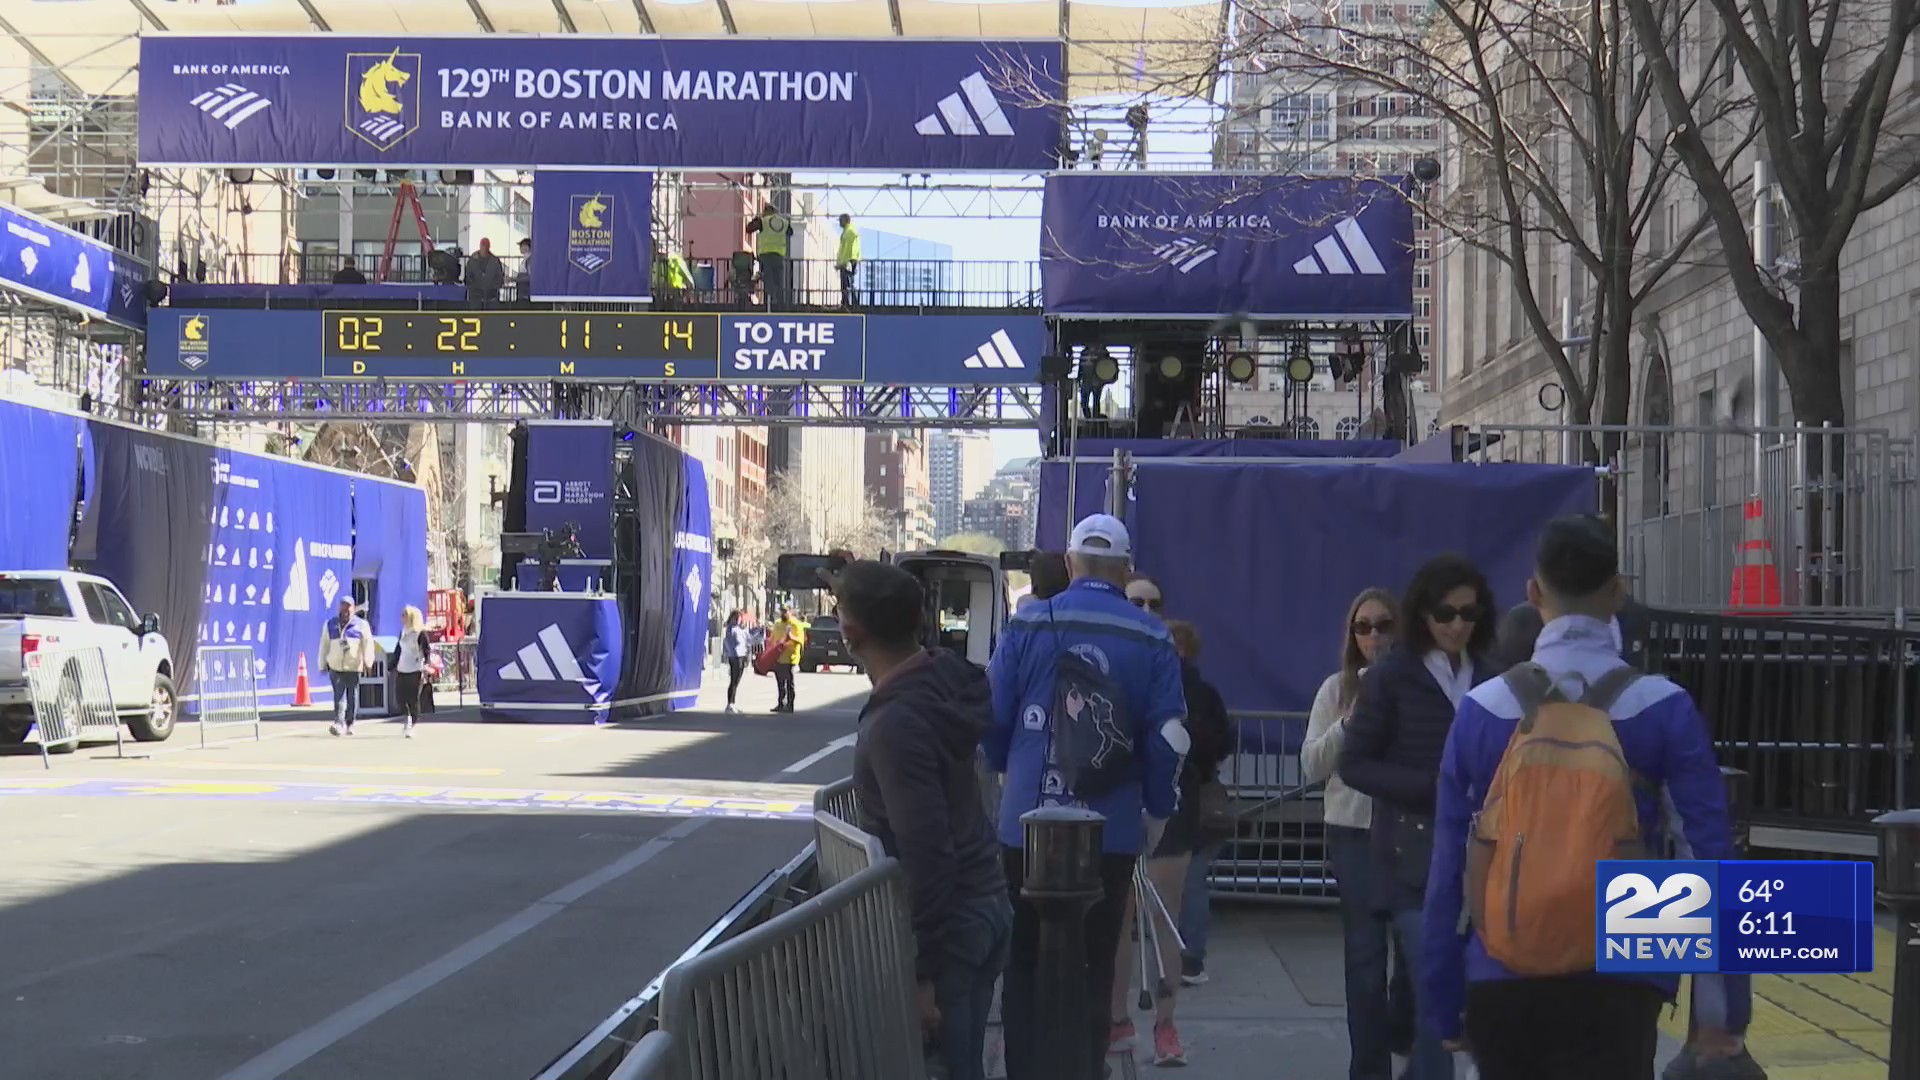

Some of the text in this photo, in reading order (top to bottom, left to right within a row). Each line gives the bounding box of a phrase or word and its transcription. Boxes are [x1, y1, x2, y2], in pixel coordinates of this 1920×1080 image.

[173, 64, 290, 76] BANK OF AMERICA
[514, 68, 652, 100] BOSTON
[661, 69, 855, 102] MARATHON
[440, 110, 679, 131] BANK OF AMERICA
[1097, 214, 1272, 229] BANK OF AMERICA
[571, 229, 611, 239] BOSTON
[338, 316, 383, 351] 02
[436, 317, 481, 352] 22
[560, 318, 591, 351] 11
[663, 319, 694, 352] 14
[733, 321, 835, 345] TO THE
[352, 361, 676, 376] D H M S
[733, 348, 826, 371] START
